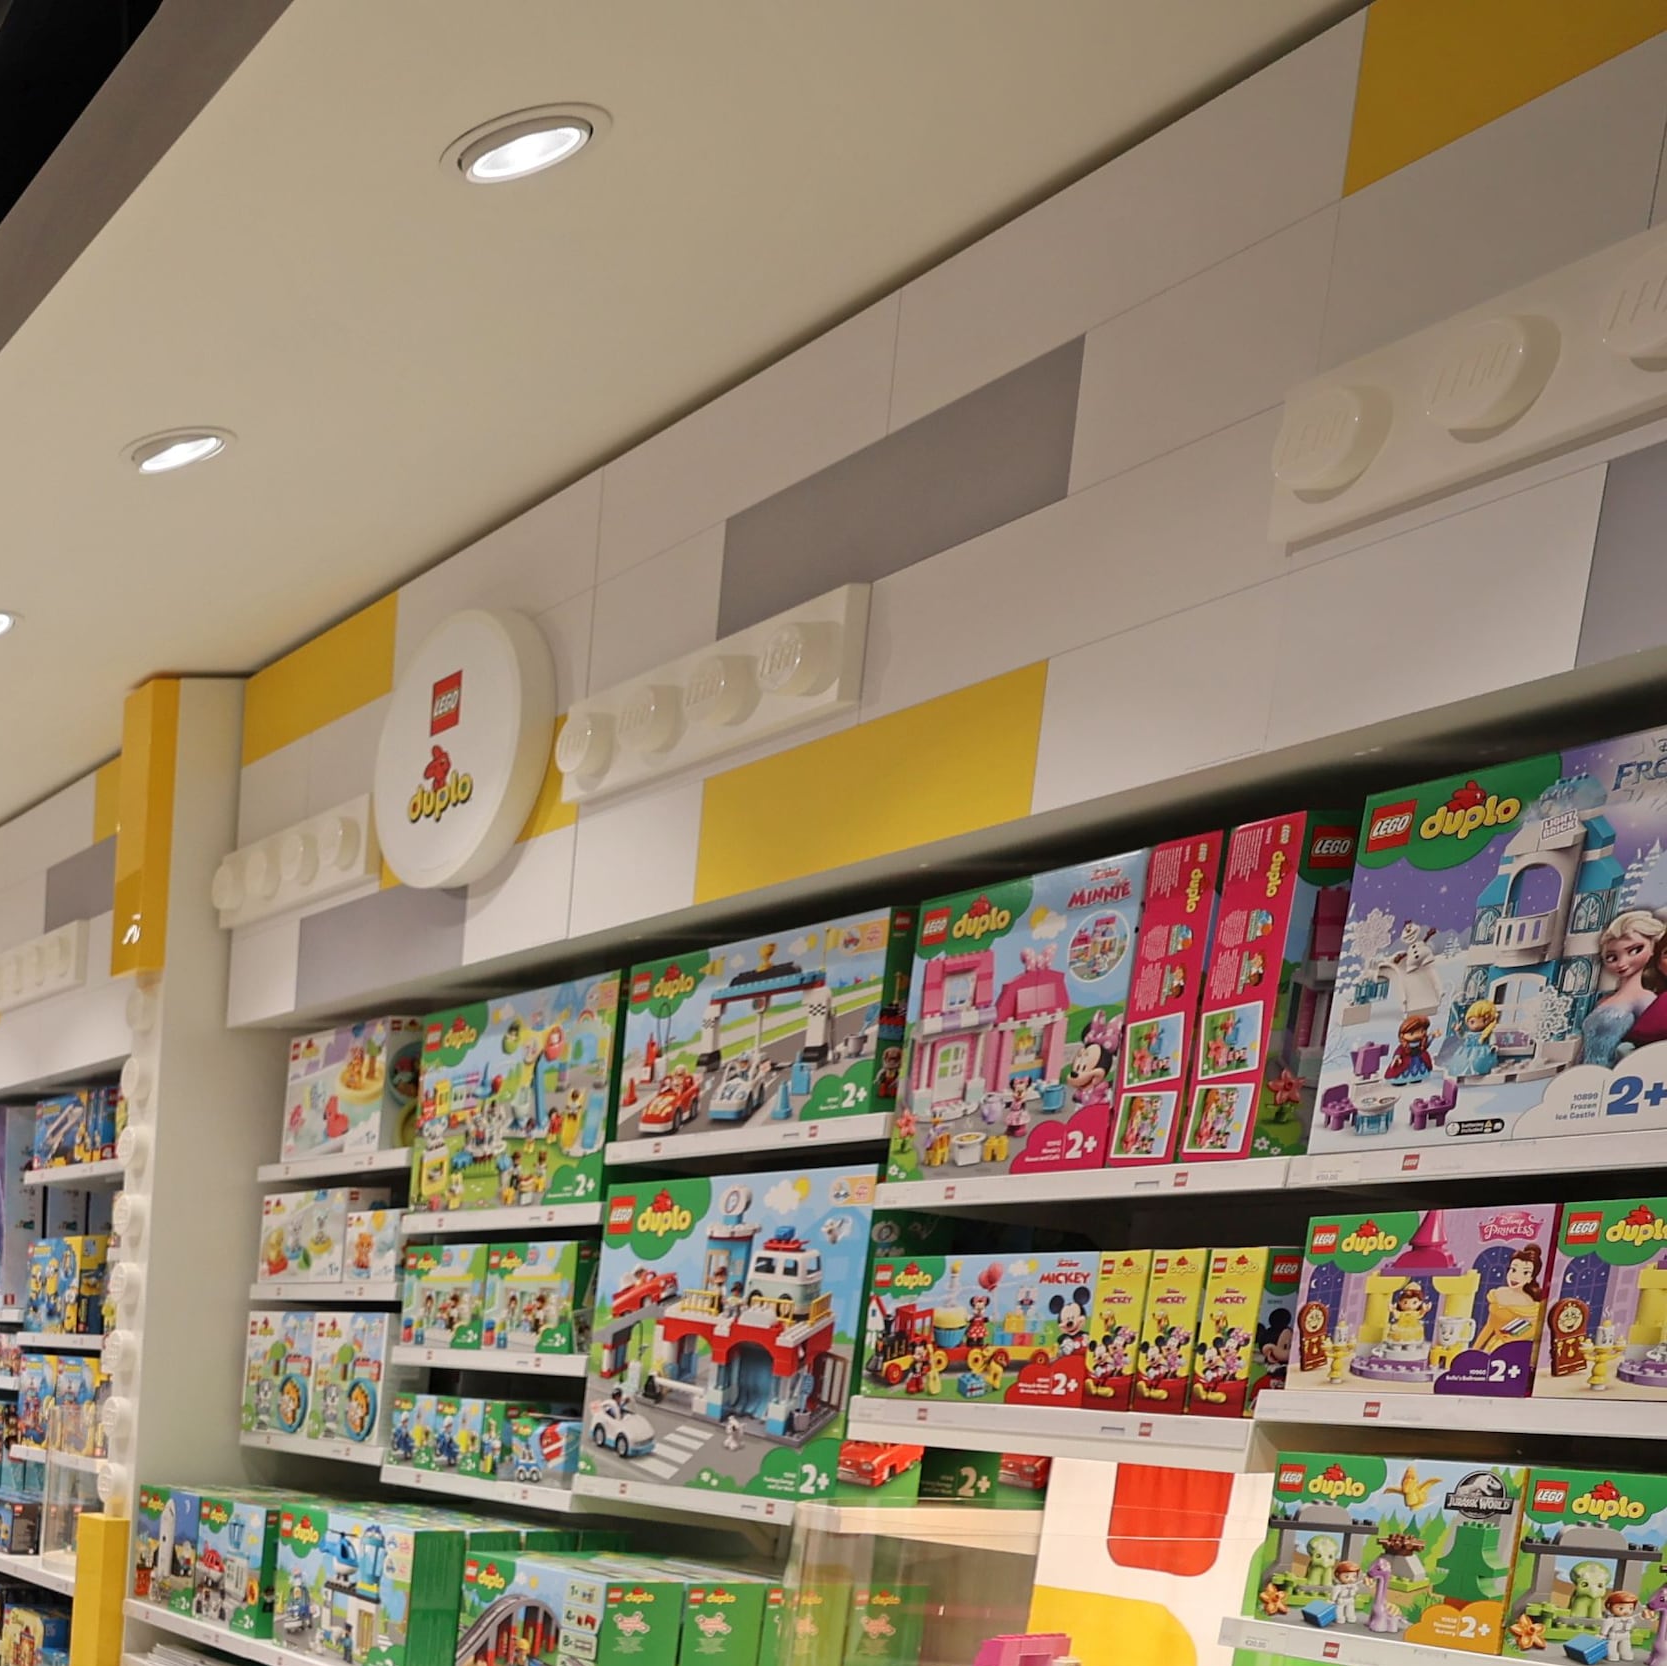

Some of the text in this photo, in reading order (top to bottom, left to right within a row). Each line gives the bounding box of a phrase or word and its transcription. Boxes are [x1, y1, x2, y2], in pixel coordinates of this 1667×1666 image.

[433, 690, 459, 720] LEGO
[408, 769, 474, 824] duplo
[1371, 795, 1521, 841] LEGO duplo
[952, 906, 1012, 940] duplo
[1569, 1101, 1598, 1112] Frozen
[1605, 1075, 1667, 1116] 2+
[1554, 1109, 1596, 1121] Ice Castle
[1064, 1129, 1099, 1161] 2+
[637, 1204, 692, 1238] duplo
[1569, 1219, 1598, 1235] LEGO
[1312, 1230, 1398, 1256] LEGO duplo
[1038, 1270, 1091, 1286] MICKEY
[1488, 1359, 1521, 1383] 2+
[1280, 1471, 1366, 1501] LEGO duplo
[1536, 1486, 1647, 1521] LEGO duplo
[1459, 1615, 1492, 1639] 2+
